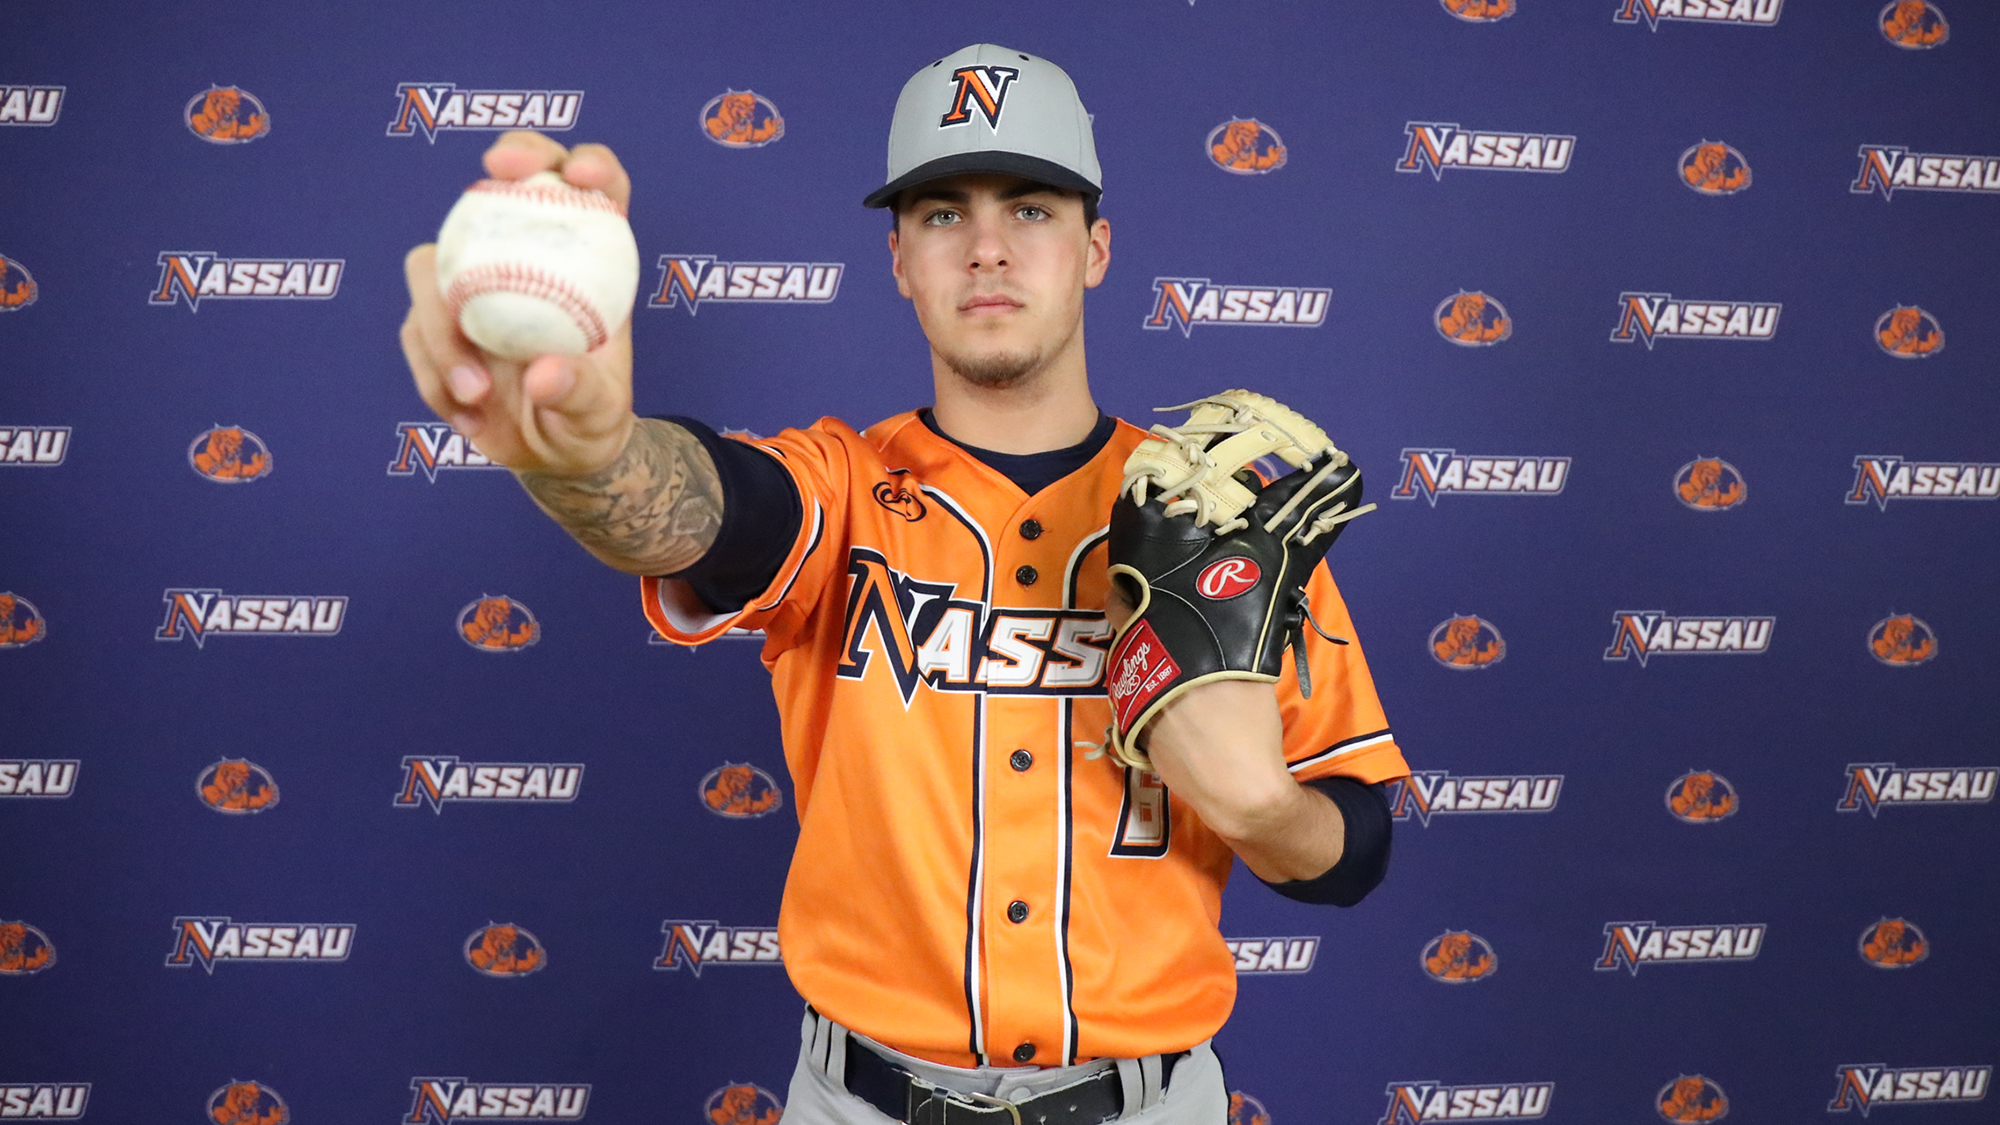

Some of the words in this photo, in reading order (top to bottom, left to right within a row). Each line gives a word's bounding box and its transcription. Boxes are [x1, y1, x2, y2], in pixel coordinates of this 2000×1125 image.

[390, 86, 581, 141] NASSAU
[939, 65, 1020, 135] N
[1399, 124, 1573, 178] NASSAU
[152, 255, 342, 310] NASSAU
[652, 258, 841, 313] NASSAU
[1146, 280, 1330, 334] NASSAU
[1613, 295, 1779, 346] NASSAU
[1394, 451, 1568, 504] NASSAU
[1848, 458, 2000, 509] NASSAU
[158, 591, 345, 645] NASSAU
[838, 548, 1114, 709] NASS
[1607, 613, 1773, 664] NASSAU
[396, 759, 582, 811] NASSAU
[1395, 774, 1561, 824] NASSAU
[1840, 766, 2000, 814] NASSAU
[168, 919, 354, 971] NASSAU
[656, 923, 779, 973] NASS
[1235, 939, 1317, 970] SAU
[1597, 924, 1764, 972] NASSAU
[0, 1086, 89, 1117] SAU
[406, 1080, 589, 1125] NASSAU
[1382, 1084, 1552, 1125] NASSAU
[1830, 1066, 1990, 1111] NASSAU
